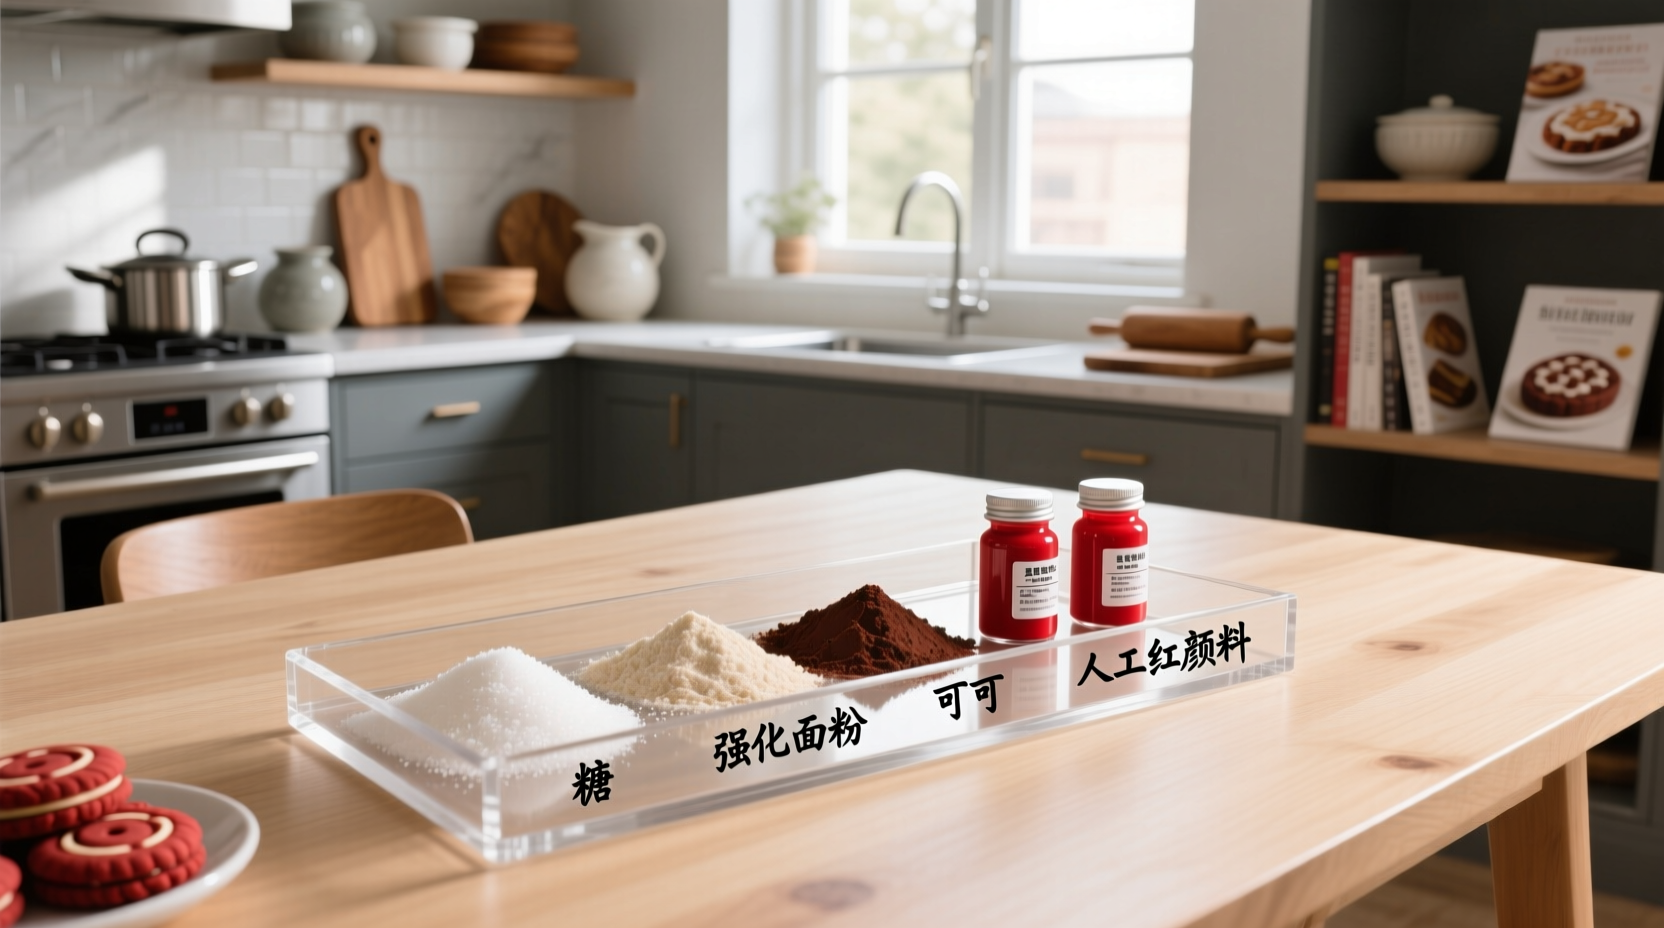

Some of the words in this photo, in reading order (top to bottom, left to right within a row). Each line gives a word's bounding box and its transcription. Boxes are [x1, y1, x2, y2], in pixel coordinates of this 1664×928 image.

[1077, 621, 1252, 687] 人工红颜料
[933, 673, 1005, 721] 可可
[713, 706, 868, 773] 强化面粉
[571, 759, 615, 807] 糖
